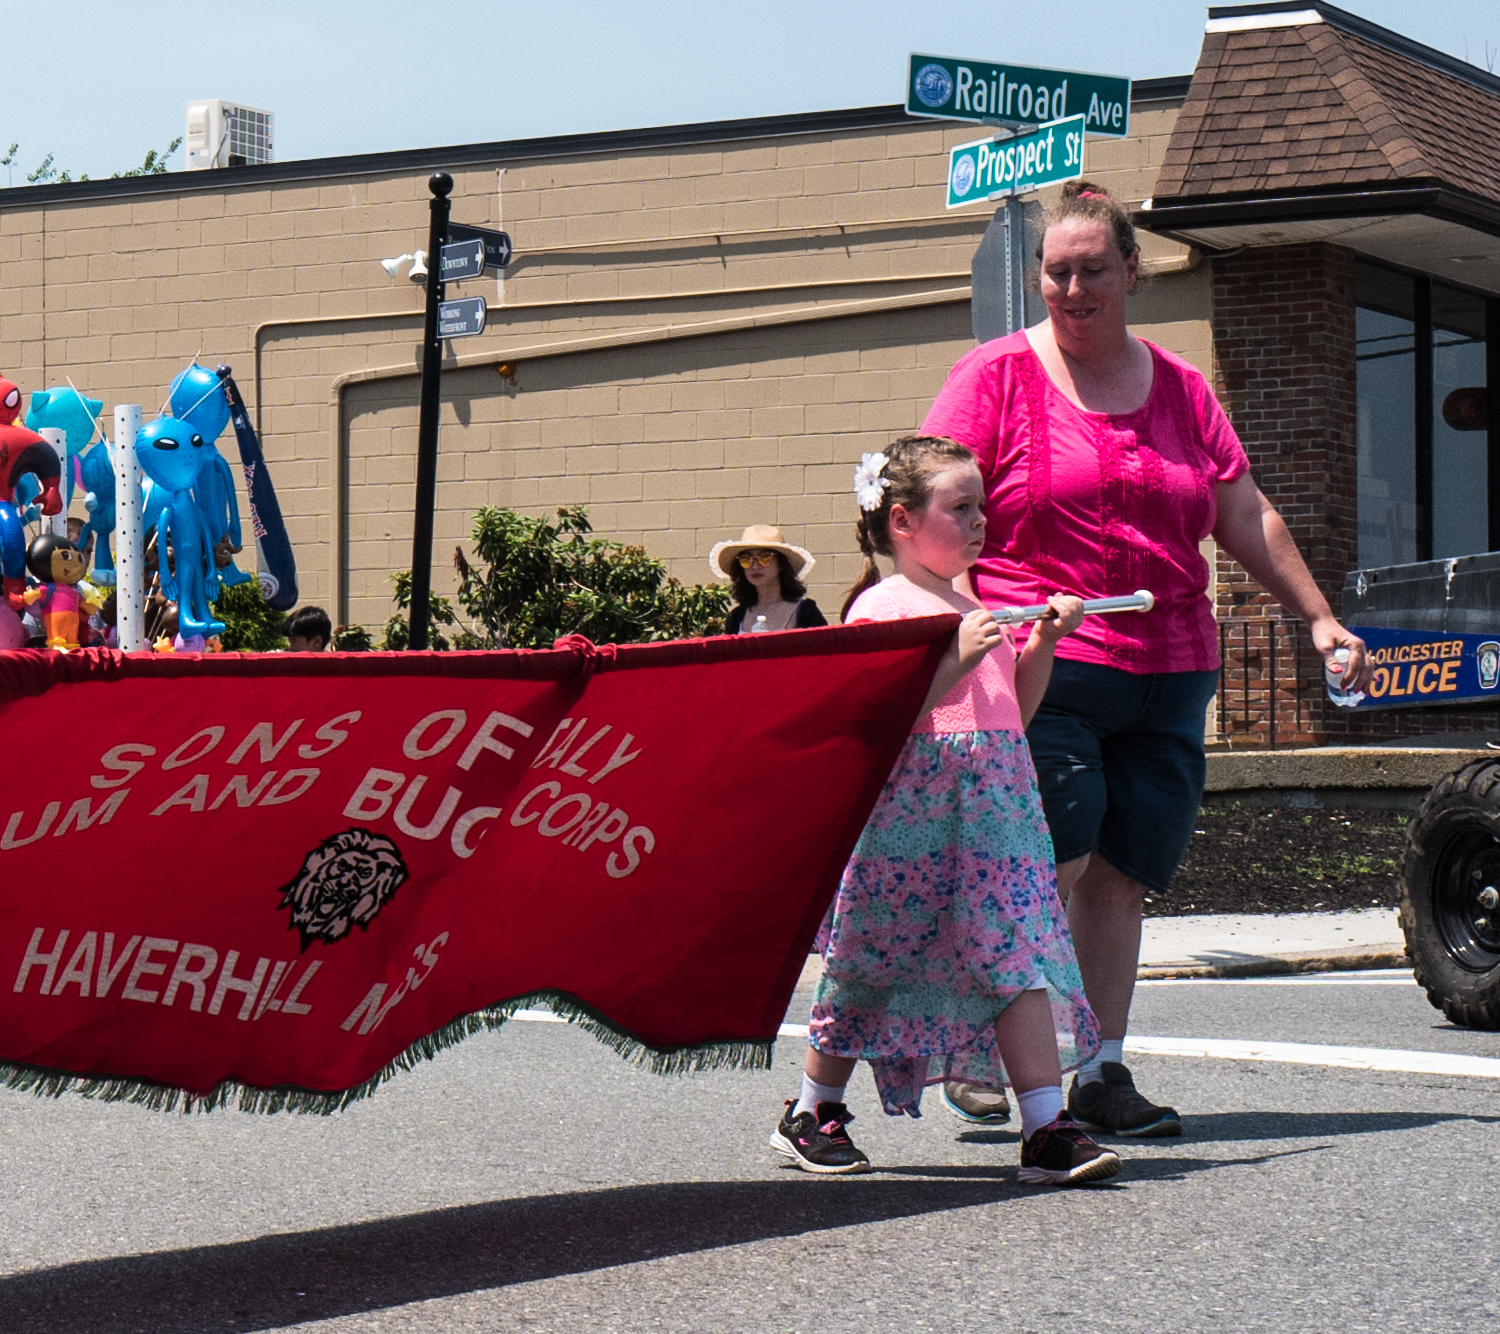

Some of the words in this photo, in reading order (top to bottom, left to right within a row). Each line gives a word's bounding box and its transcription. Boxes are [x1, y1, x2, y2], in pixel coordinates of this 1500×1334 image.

[955, 67, 1068, 123] Railroad
[1086, 93, 1123, 128] Ave
[976, 127, 1054, 188] Prospect
[1063, 131, 1080, 167] St
[1370, 661, 1461, 698] OLICE
[90, 710, 362, 788] SONS
[402, 709, 534, 771] OF
[150, 768, 320, 816] AND
[510, 781, 656, 879] CORPS
